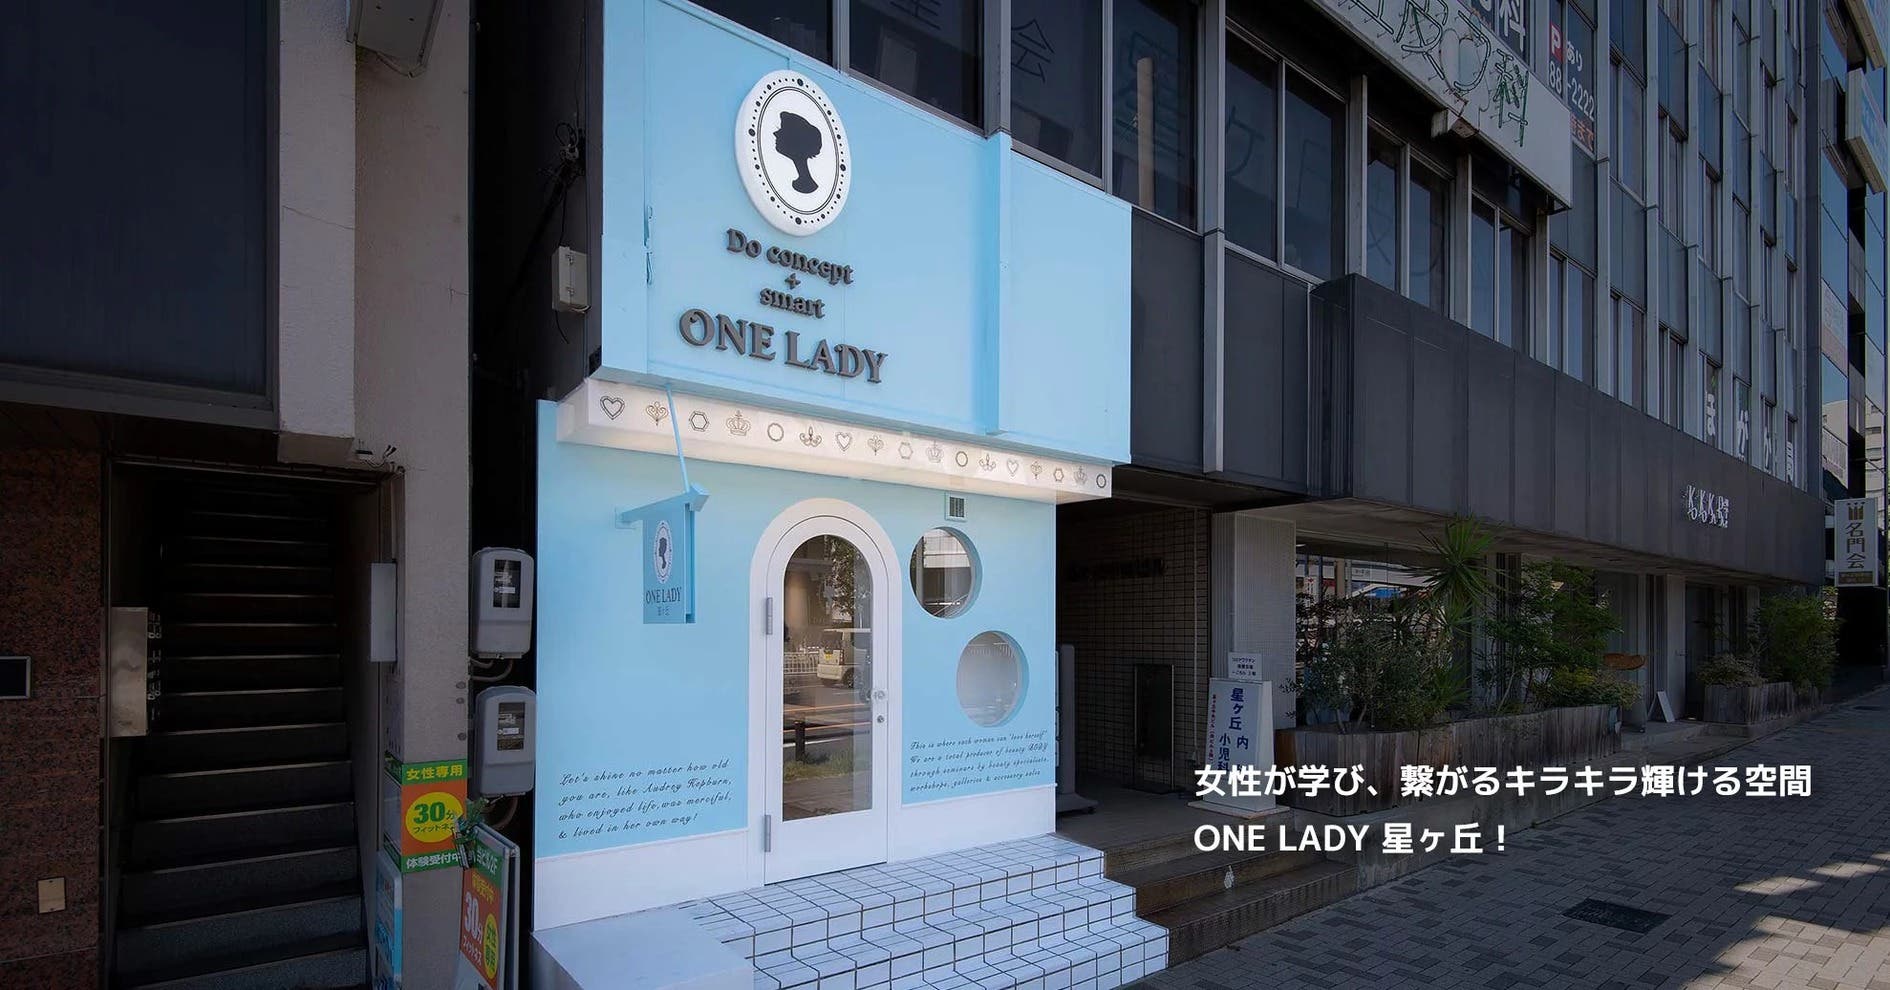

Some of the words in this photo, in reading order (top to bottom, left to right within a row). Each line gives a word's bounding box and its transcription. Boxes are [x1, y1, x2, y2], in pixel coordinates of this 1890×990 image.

[726, 228, 762, 258] Do
[766, 245, 854, 285] concept
[759, 287, 825, 319] smart
[679, 308, 776, 361] ONE
[784, 330, 888, 383] LADY
[1845, 522, 1866, 569] 名門会
[406, 764, 463, 781] 女性専用
[559, 772, 589, 786] Let's
[593, 770, 625, 782] shine
[628, 770, 643, 778] no
[647, 765, 683, 776] matter
[686, 761, 708, 773] how
[711, 758, 730, 770] old
[558, 794, 584, 806] you
[616, 784, 638, 796] like
[643, 782, 682, 795] Audrey
[558, 810, 584, 821] who
[587, 804, 634, 820] enjoyed
[573, 824, 602, 838] lived
[607, 823, 618, 833] in
[623, 819, 641, 831] her
[646, 818, 667, 827] own
[671, 812, 698, 826] way!
[413, 823, 456, 834] フィットネ
